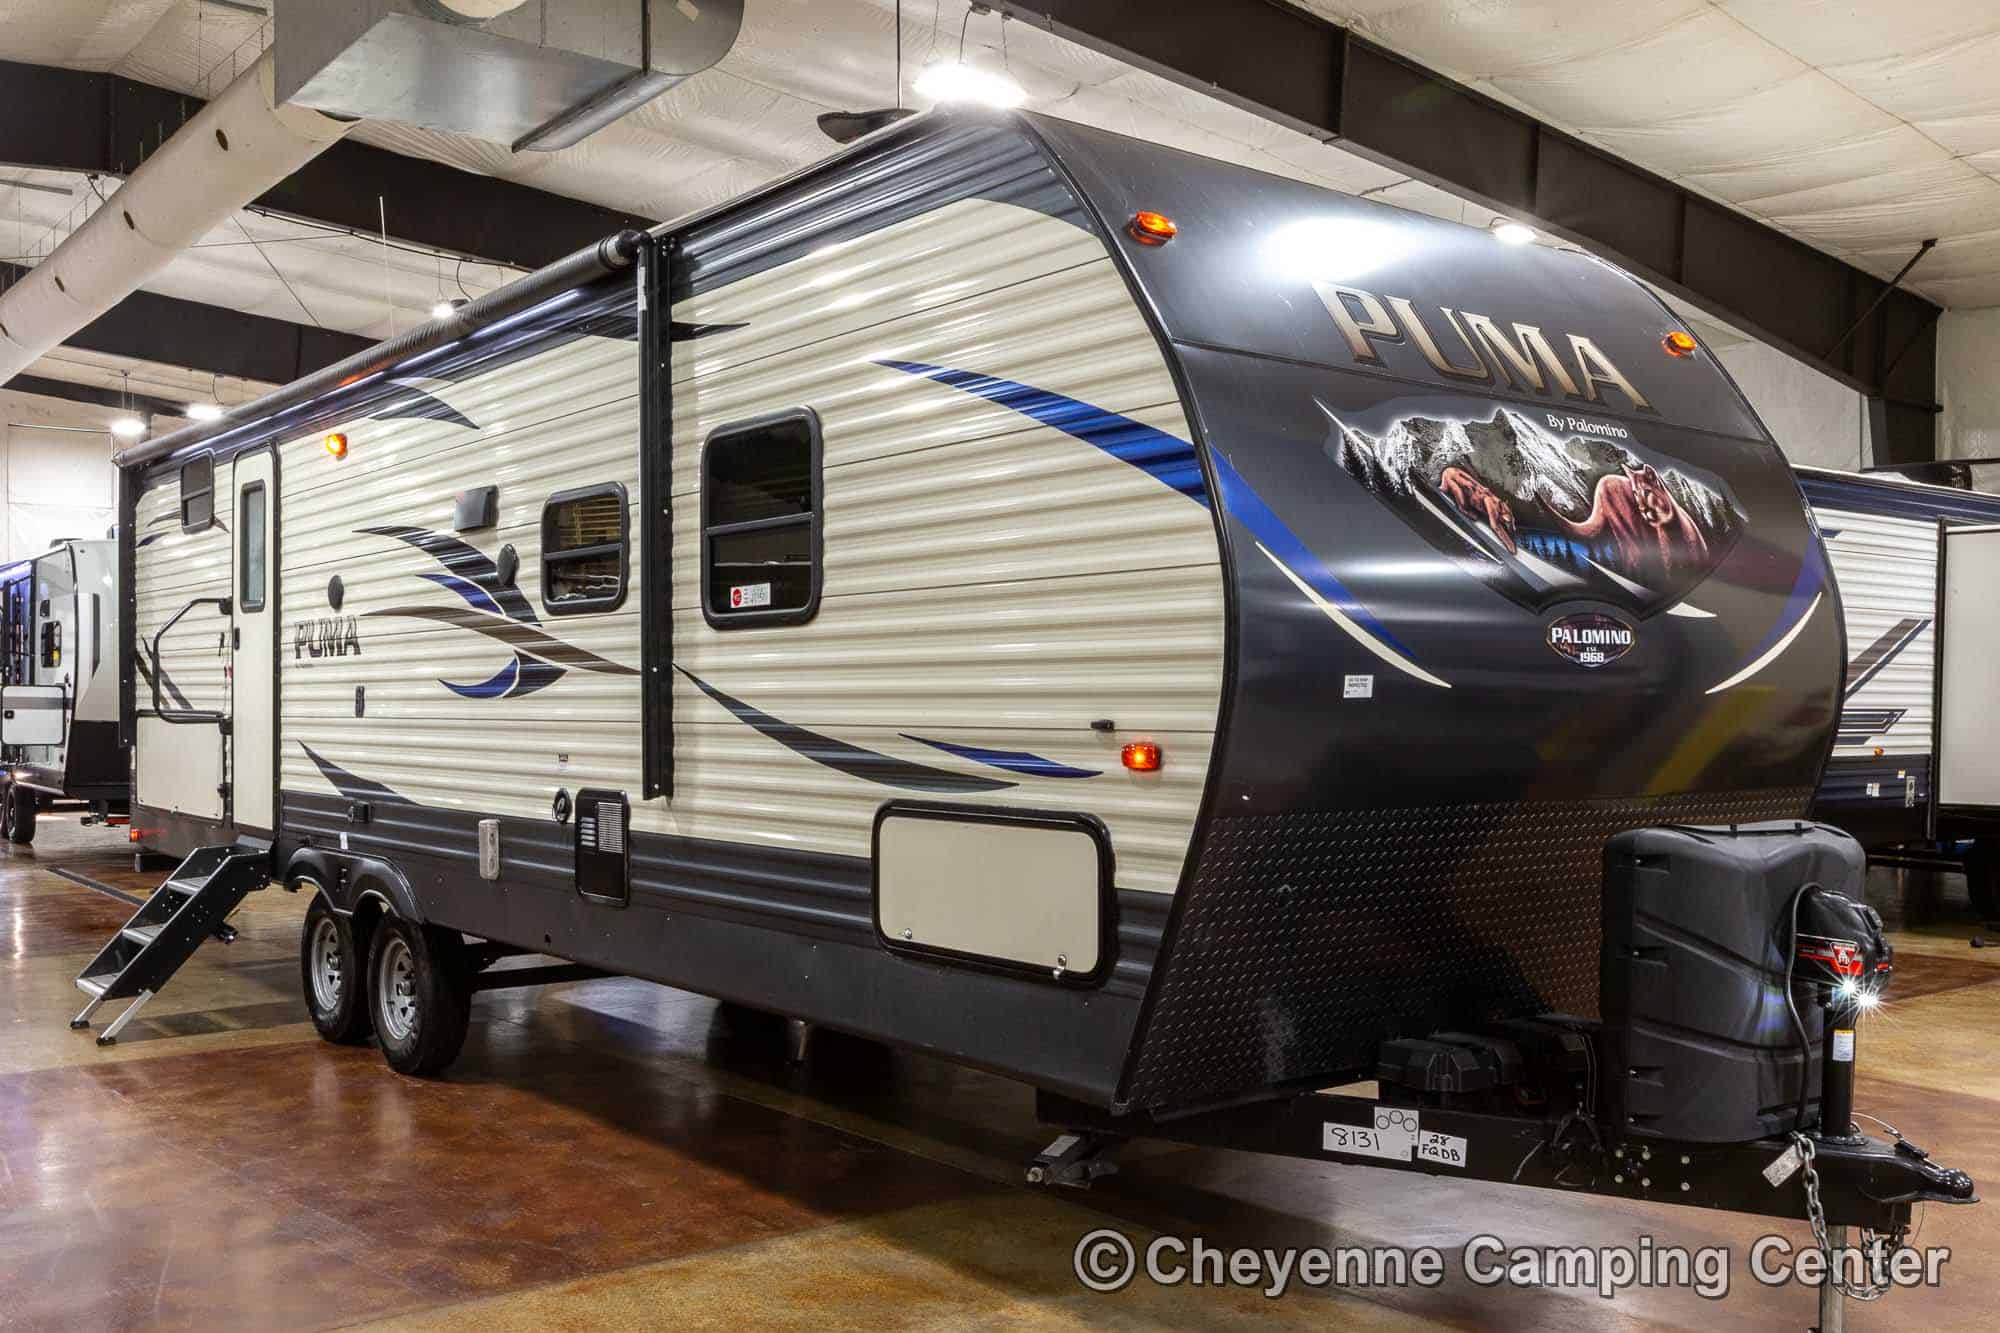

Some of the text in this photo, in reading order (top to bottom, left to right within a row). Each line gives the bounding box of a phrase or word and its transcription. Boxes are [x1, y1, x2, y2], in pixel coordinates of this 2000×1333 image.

[1312, 280, 1657, 412] PUMA
[1546, 414, 1628, 438] By Palomino
[295, 615, 361, 659] PUMA
[1551, 627, 1631, 645] PALOMINO
[1580, 652, 1604, 663] 1968
[1331, 1128, 1380, 1151] 8131
[1429, 1134, 1451, 1146] 28
